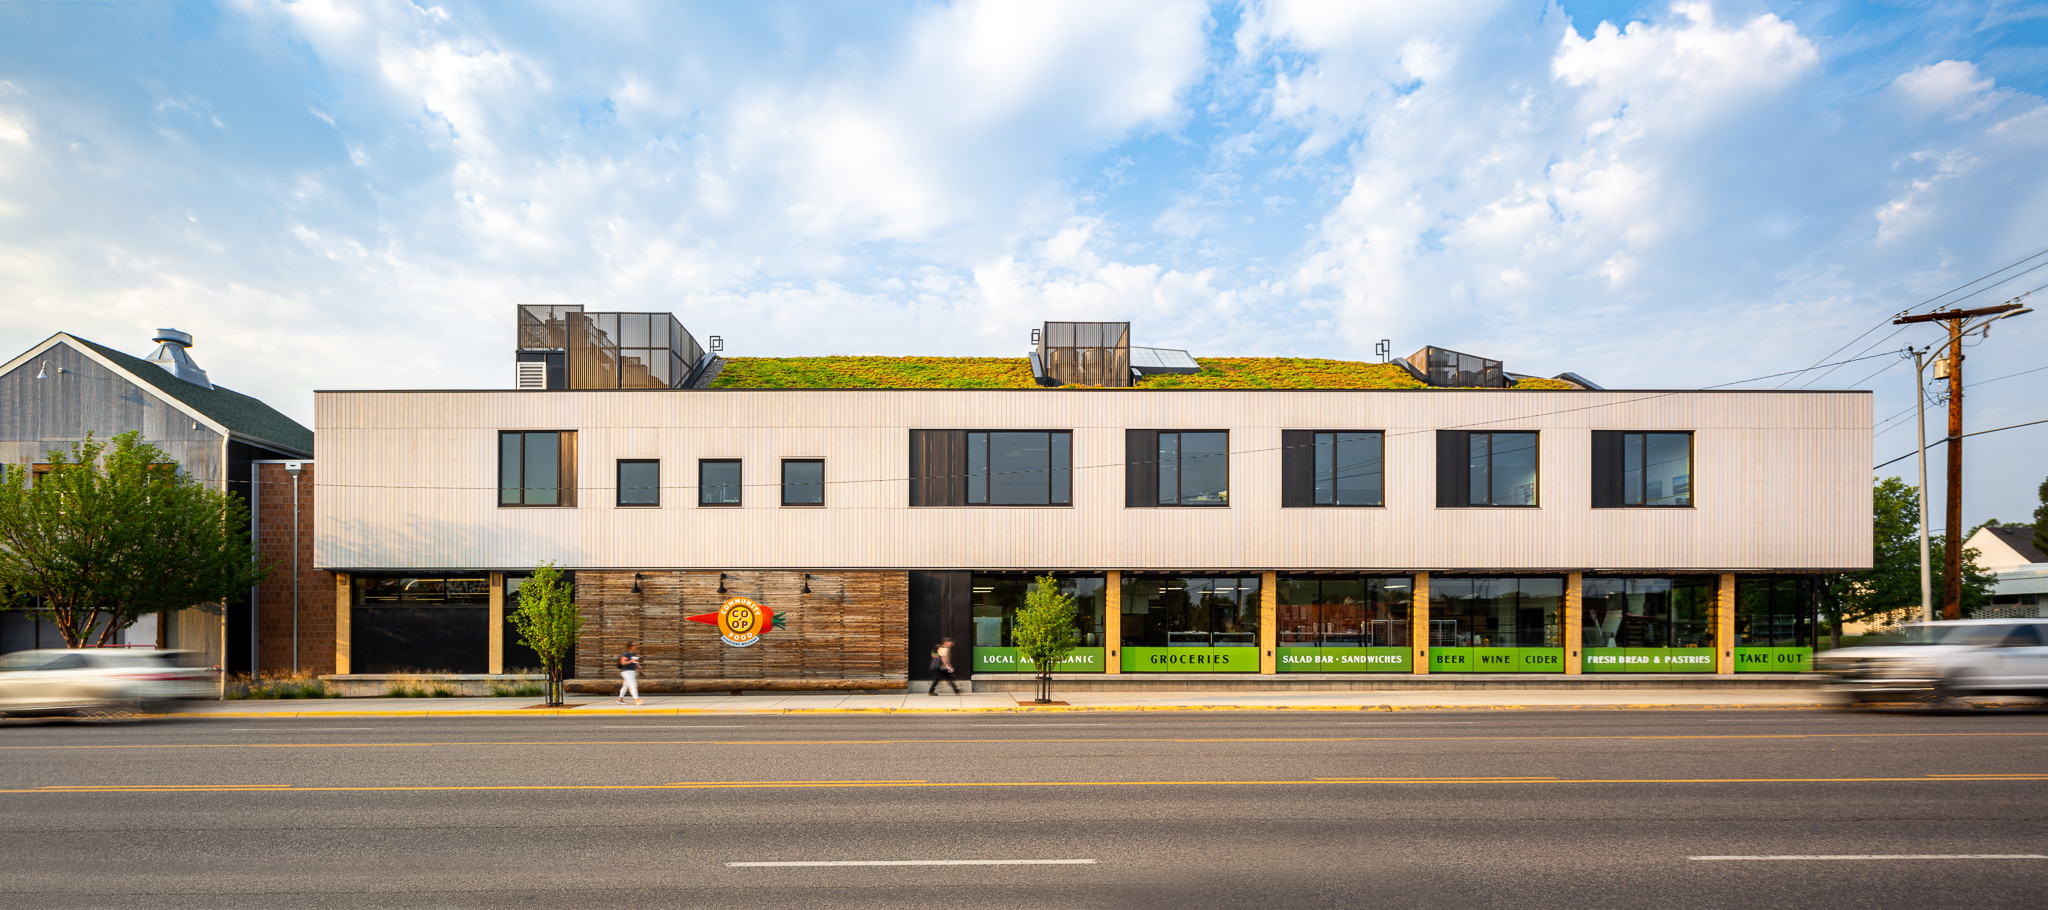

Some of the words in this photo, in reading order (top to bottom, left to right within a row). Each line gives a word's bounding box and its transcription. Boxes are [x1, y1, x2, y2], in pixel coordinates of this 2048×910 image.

[721, 598, 761, 616] COMMUNITY
[728, 632, 753, 640] FOOD
[983, 655, 1015, 664] LOCAL
[1150, 654, 1229, 664] GROCERIES
[1282, 655, 1312, 664] SALAD
[1315, 655, 1334, 664] BAR
[1341, 655, 1403, 664] SANDWICHES
[1437, 655, 1465, 664] BEER
[1482, 655, 1510, 664] WINE
[1526, 655, 1558, 664] CIDER
[1587, 655, 1616, 664] FRESH
[1618, 655, 1649, 664] BREAD
[1653, 655, 1661, 664] &
[1664, 655, 1711, 664] PASTRIES
[1739, 654, 1769, 663] TAKE
[1777, 654, 1803, 663] OUT
